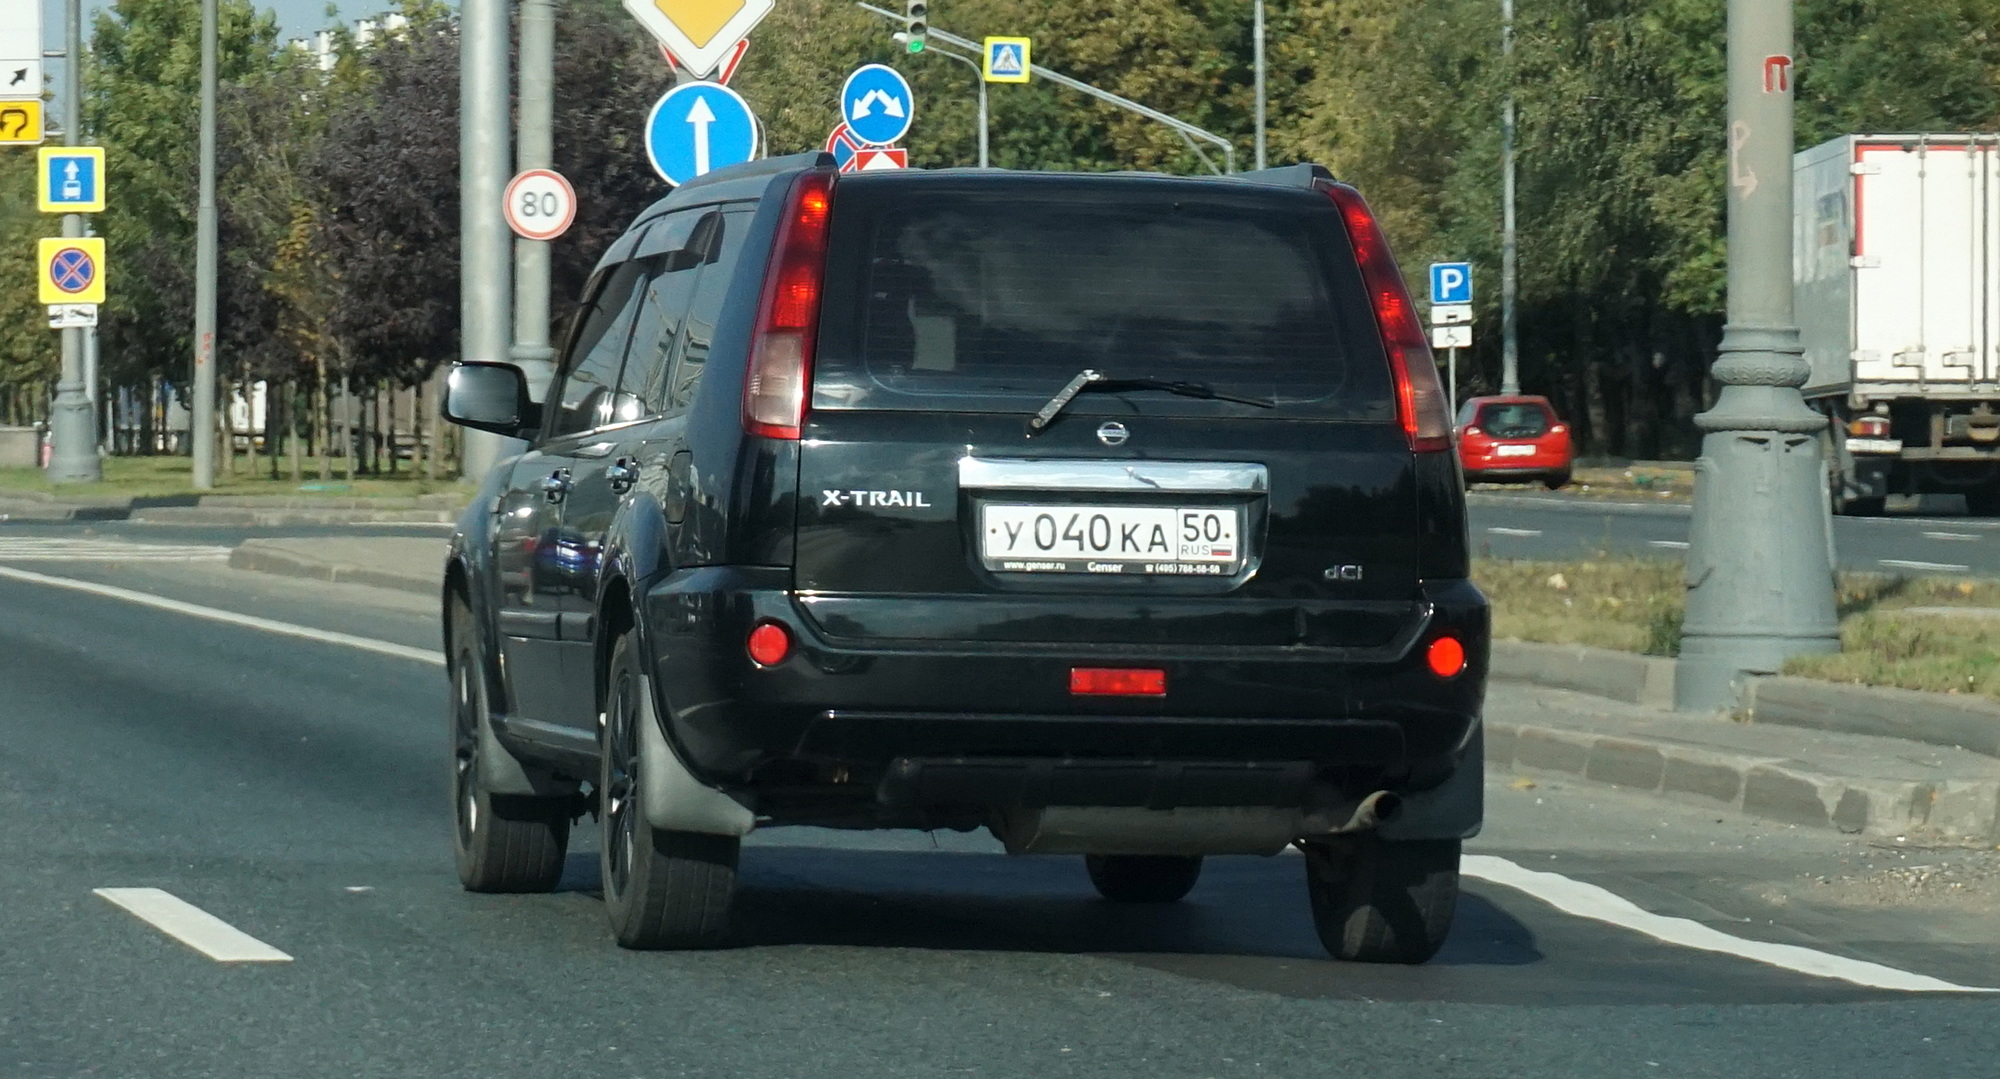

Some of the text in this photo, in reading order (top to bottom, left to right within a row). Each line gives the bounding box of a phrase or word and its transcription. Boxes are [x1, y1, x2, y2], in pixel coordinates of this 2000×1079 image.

[522, 191, 557, 217] 80
[1440, 268, 1463, 299] P
[822, 489, 931, 507] X-TRAIL
[1183, 513, 1221, 542] 50
[1181, 544, 1210, 556] RUS
[1003, 561, 1066, 572] www.genser.ru
[1087, 562, 1123, 573] Genser
[1155, 563, 1178, 574] (495)
